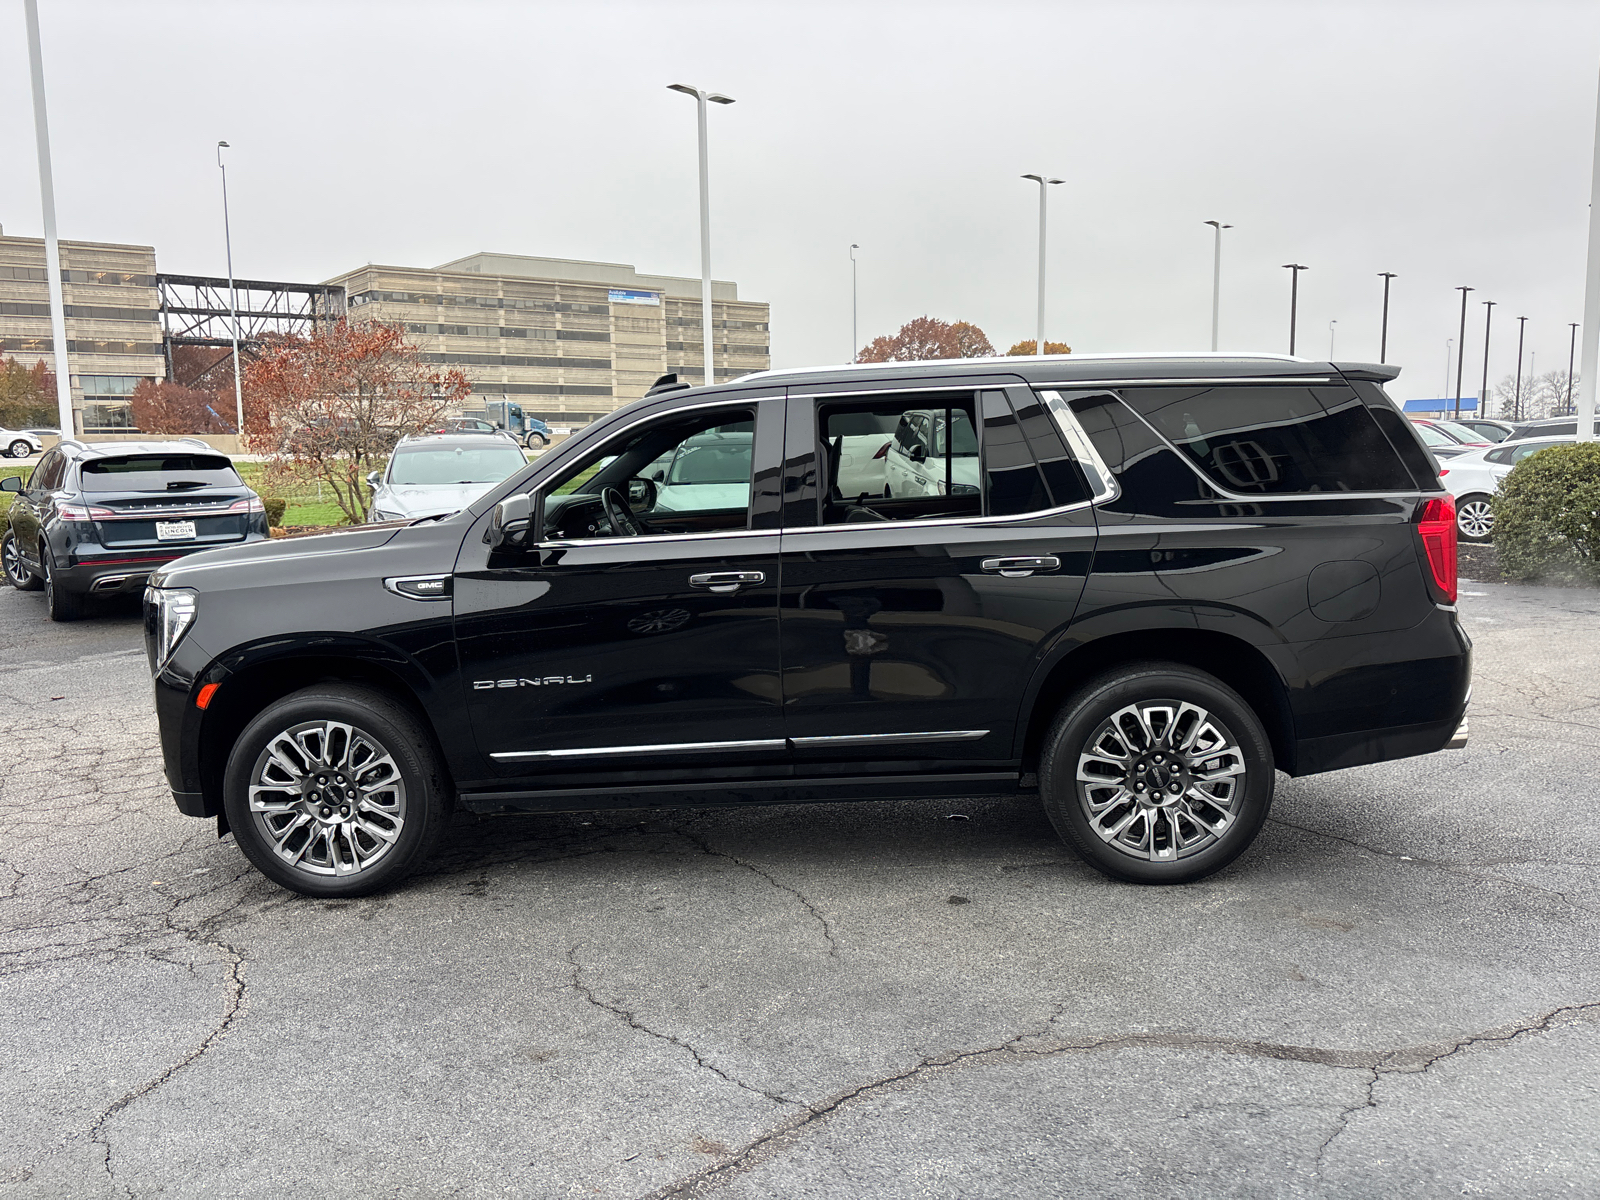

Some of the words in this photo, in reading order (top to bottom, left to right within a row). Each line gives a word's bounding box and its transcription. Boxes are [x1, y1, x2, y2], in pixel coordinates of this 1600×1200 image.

[129, 501, 217, 509] LINCOLN
[473, 674, 592, 690] DENALI
[383, 726, 420, 777] BRIDGESTONE
